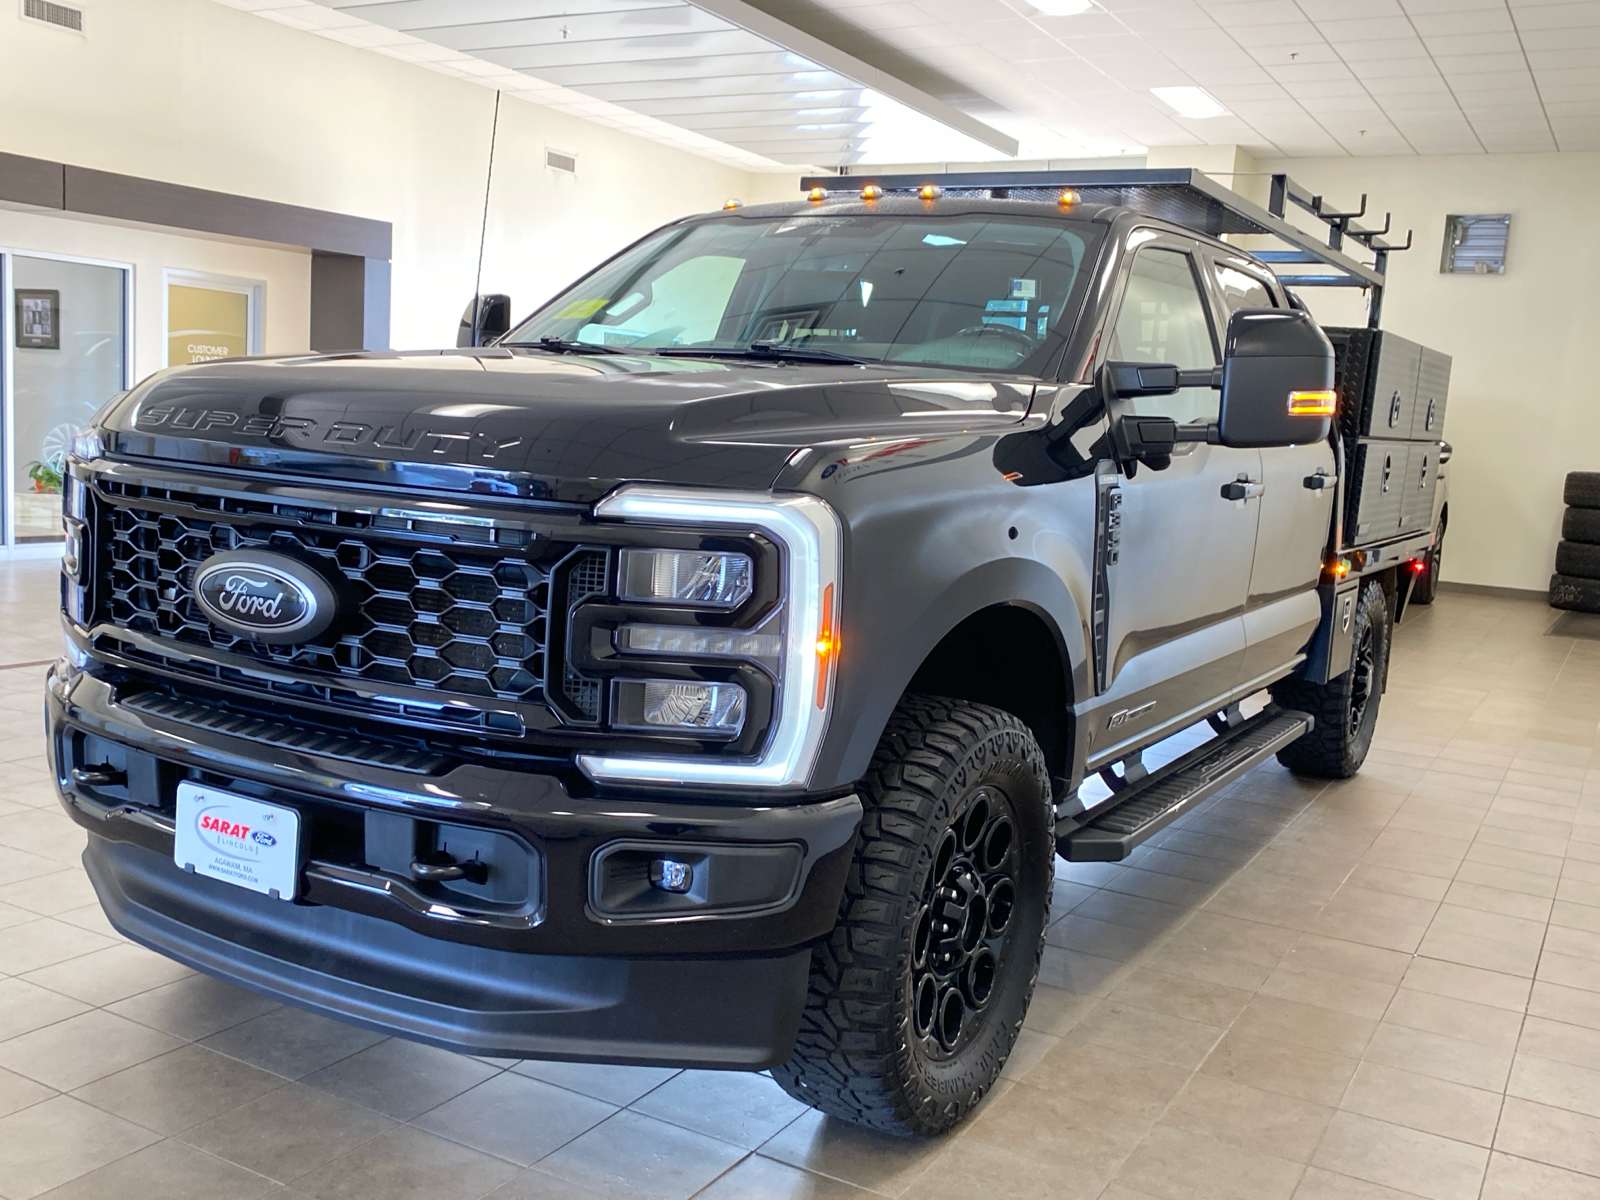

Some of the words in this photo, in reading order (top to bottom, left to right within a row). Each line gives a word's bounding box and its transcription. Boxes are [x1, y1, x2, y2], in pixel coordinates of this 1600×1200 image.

[187, 344, 228, 356] CUSTOMER
[138, 406, 318, 441] SUPER
[323, 421, 522, 458] DUTY
[219, 575, 284, 619] Ford
[201, 815, 250, 839] SARAT
[255, 832, 273, 846] Ford
[222, 838, 253, 852] LINCOLN
[243, 864, 253, 874] MA
